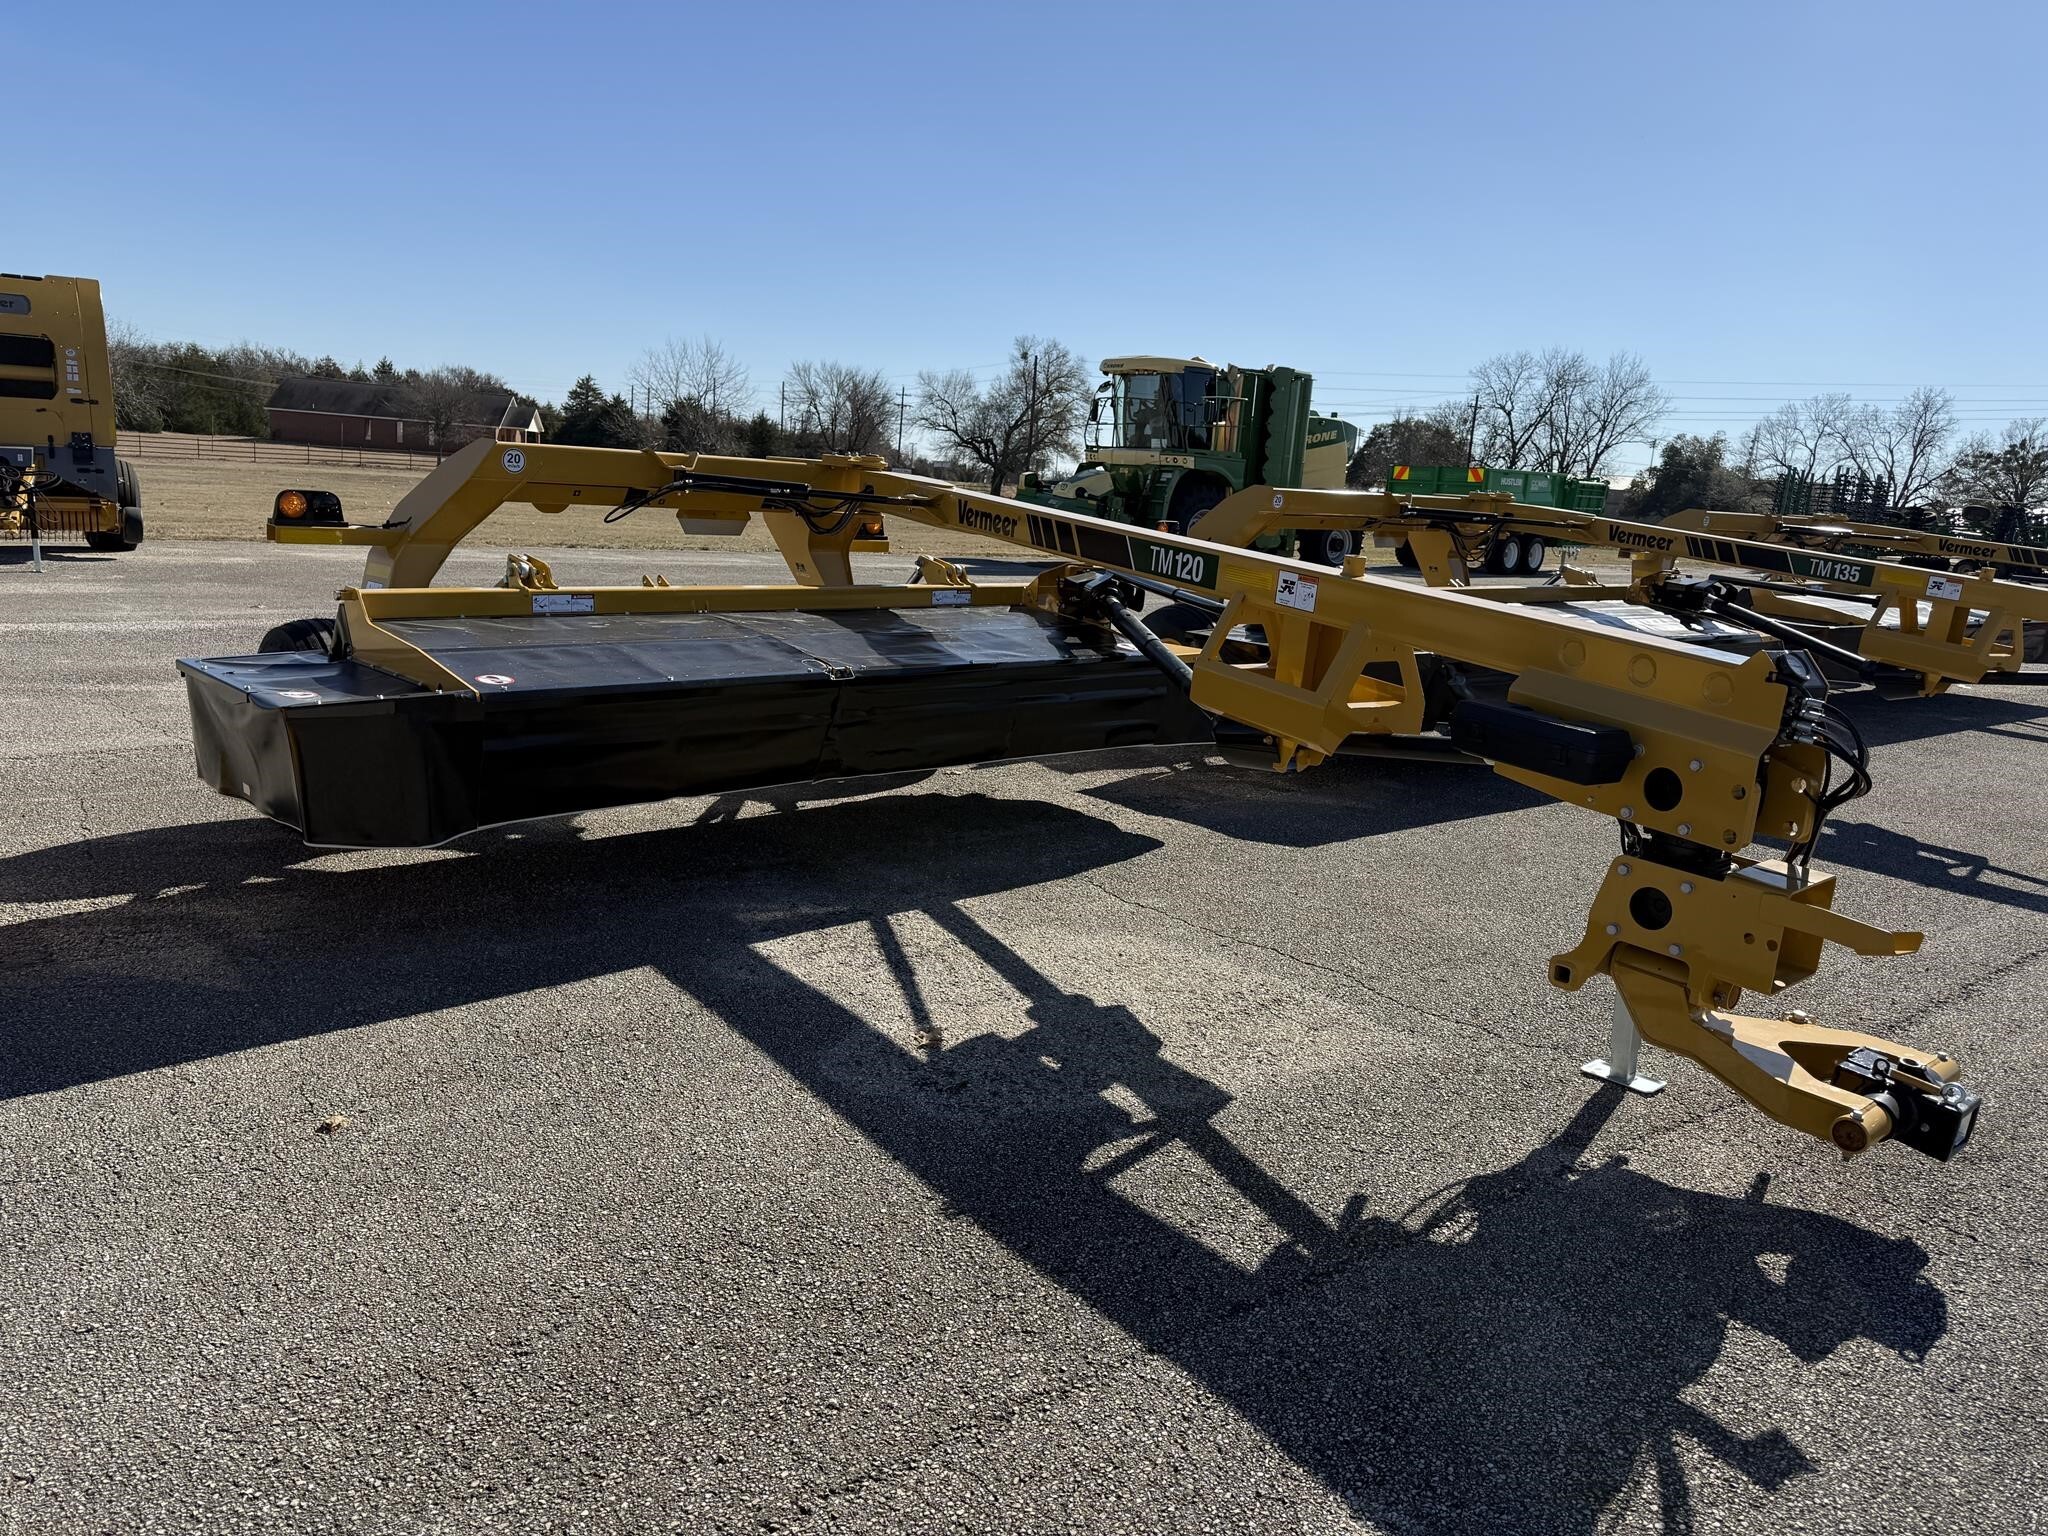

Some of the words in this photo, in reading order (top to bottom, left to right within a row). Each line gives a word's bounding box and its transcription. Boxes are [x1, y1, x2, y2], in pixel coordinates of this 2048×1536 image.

[1306, 430, 1337, 444] RONE
[507, 453, 520, 464] 20
[958, 499, 1017, 537] Vermeer
[1609, 524, 1674, 551] Vermeer
[1939, 538, 1997, 558] Vermeer
